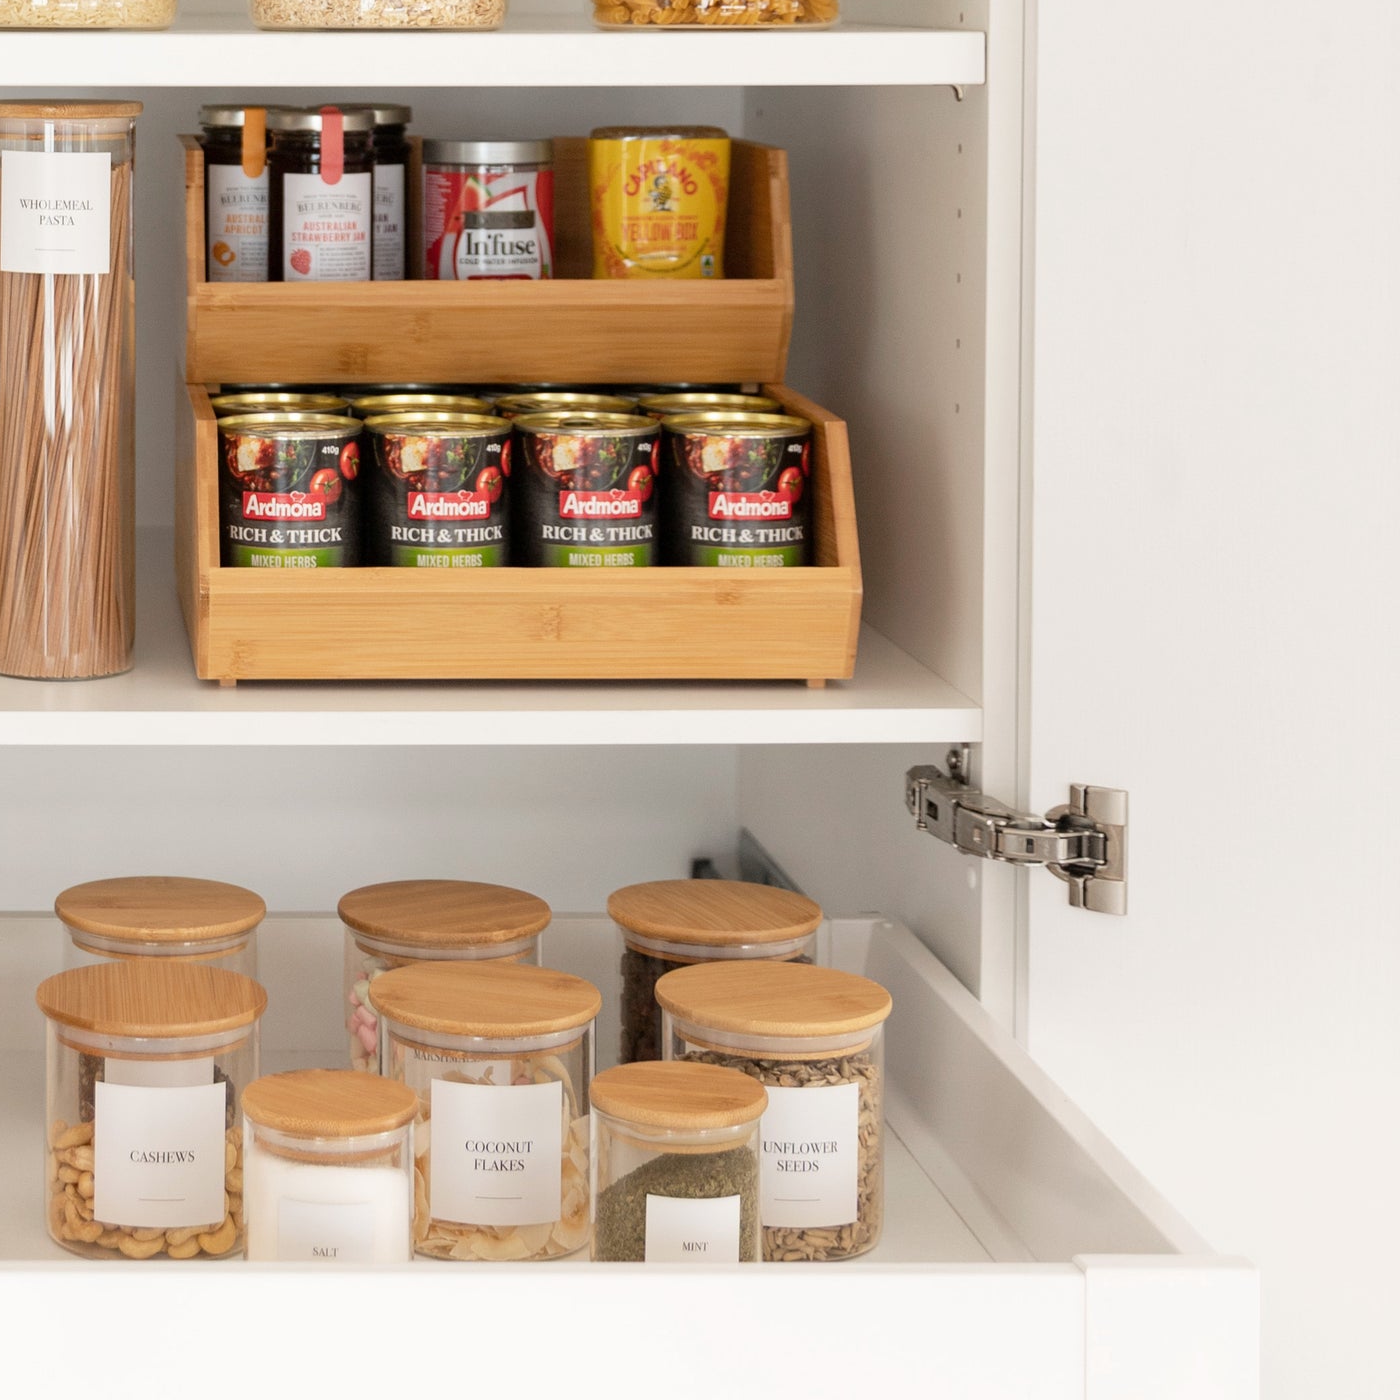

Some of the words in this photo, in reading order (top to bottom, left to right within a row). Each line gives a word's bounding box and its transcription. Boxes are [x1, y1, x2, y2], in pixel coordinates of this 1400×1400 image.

[19, 199, 93, 211] WHOLEMEAL
[39, 215, 75, 226] PASTA
[321, 445, 340, 456] 410g
[245, 493, 322, 517] Ardmona
[411, 493, 487, 517] Ardmona
[563, 493, 638, 515] Ardmona
[712, 494, 789, 516] Ardmona
[229, 525, 267, 543] RICH
[269, 529, 285, 544] &
[287, 527, 342, 544] THICK
[391, 525, 435, 543] RICH
[437, 528, 452, 543] &
[454, 525, 503, 543] THICK
[542, 524, 586, 541] RICH
[589, 527, 605, 541] &
[606, 524, 653, 541] THICK
[691, 525, 736, 542] RICH
[738, 529, 755, 542] &
[756, 526, 804, 542] THICK
[251, 554, 282, 568] MIXED
[284, 555, 317, 568] HERBS
[417, 554, 449, 567] MIXED
[452, 554, 483, 567] HERBS
[569, 553, 602, 567] MIXED
[604, 553, 635, 567] HERBS
[718, 554, 751, 567] MIXED
[754, 554, 785, 567] HERBS
[465, 1140, 533, 1153] COCONUT
[763, 1141, 838, 1155] UNFLOWER
[130, 1150, 195, 1163] CASHEWS
[474, 1158, 525, 1171] FLAKES
[776, 1160, 819, 1172] SEEDS
[312, 1247, 339, 1257] SALT
[682, 1241, 709, 1252] MINT
